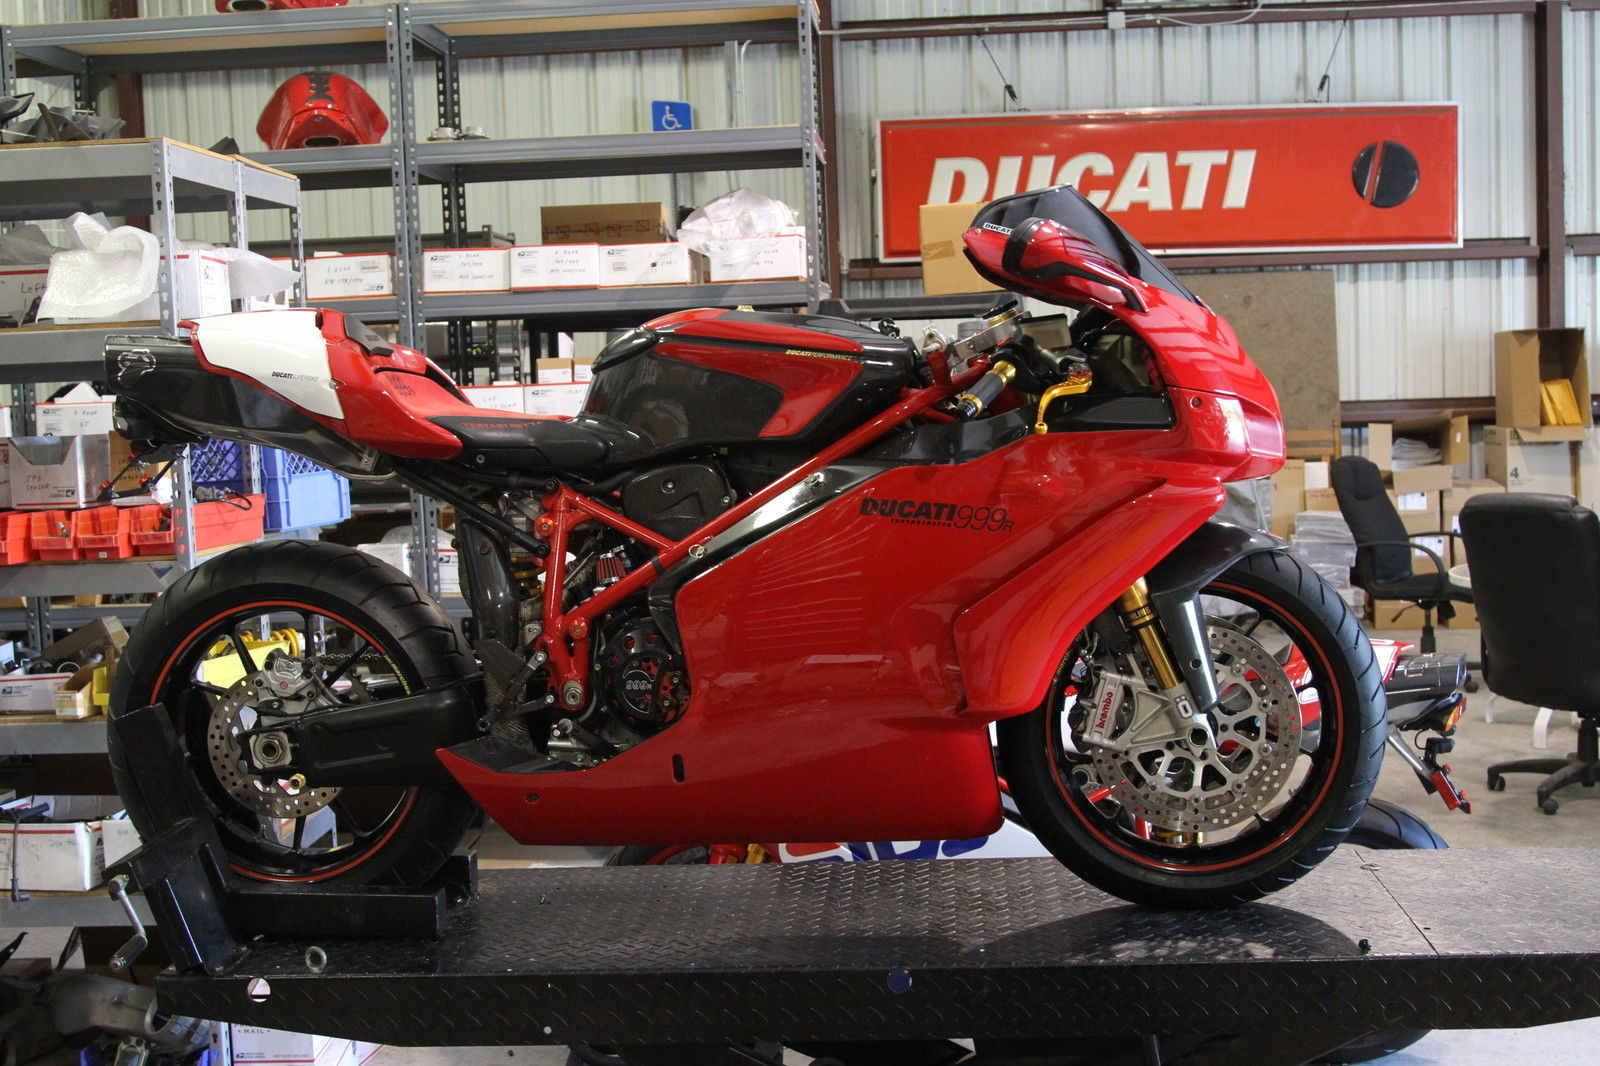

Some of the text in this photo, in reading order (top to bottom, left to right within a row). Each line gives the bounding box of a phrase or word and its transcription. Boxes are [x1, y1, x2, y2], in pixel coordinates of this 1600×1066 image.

[926, 149, 1257, 212] DUCATI
[983, 223, 1012, 235] DUCAT
[1510, 467, 1520, 479] 4
[860, 498, 957, 521] DUCATI
[1095, 691, 1114, 729] brembo
